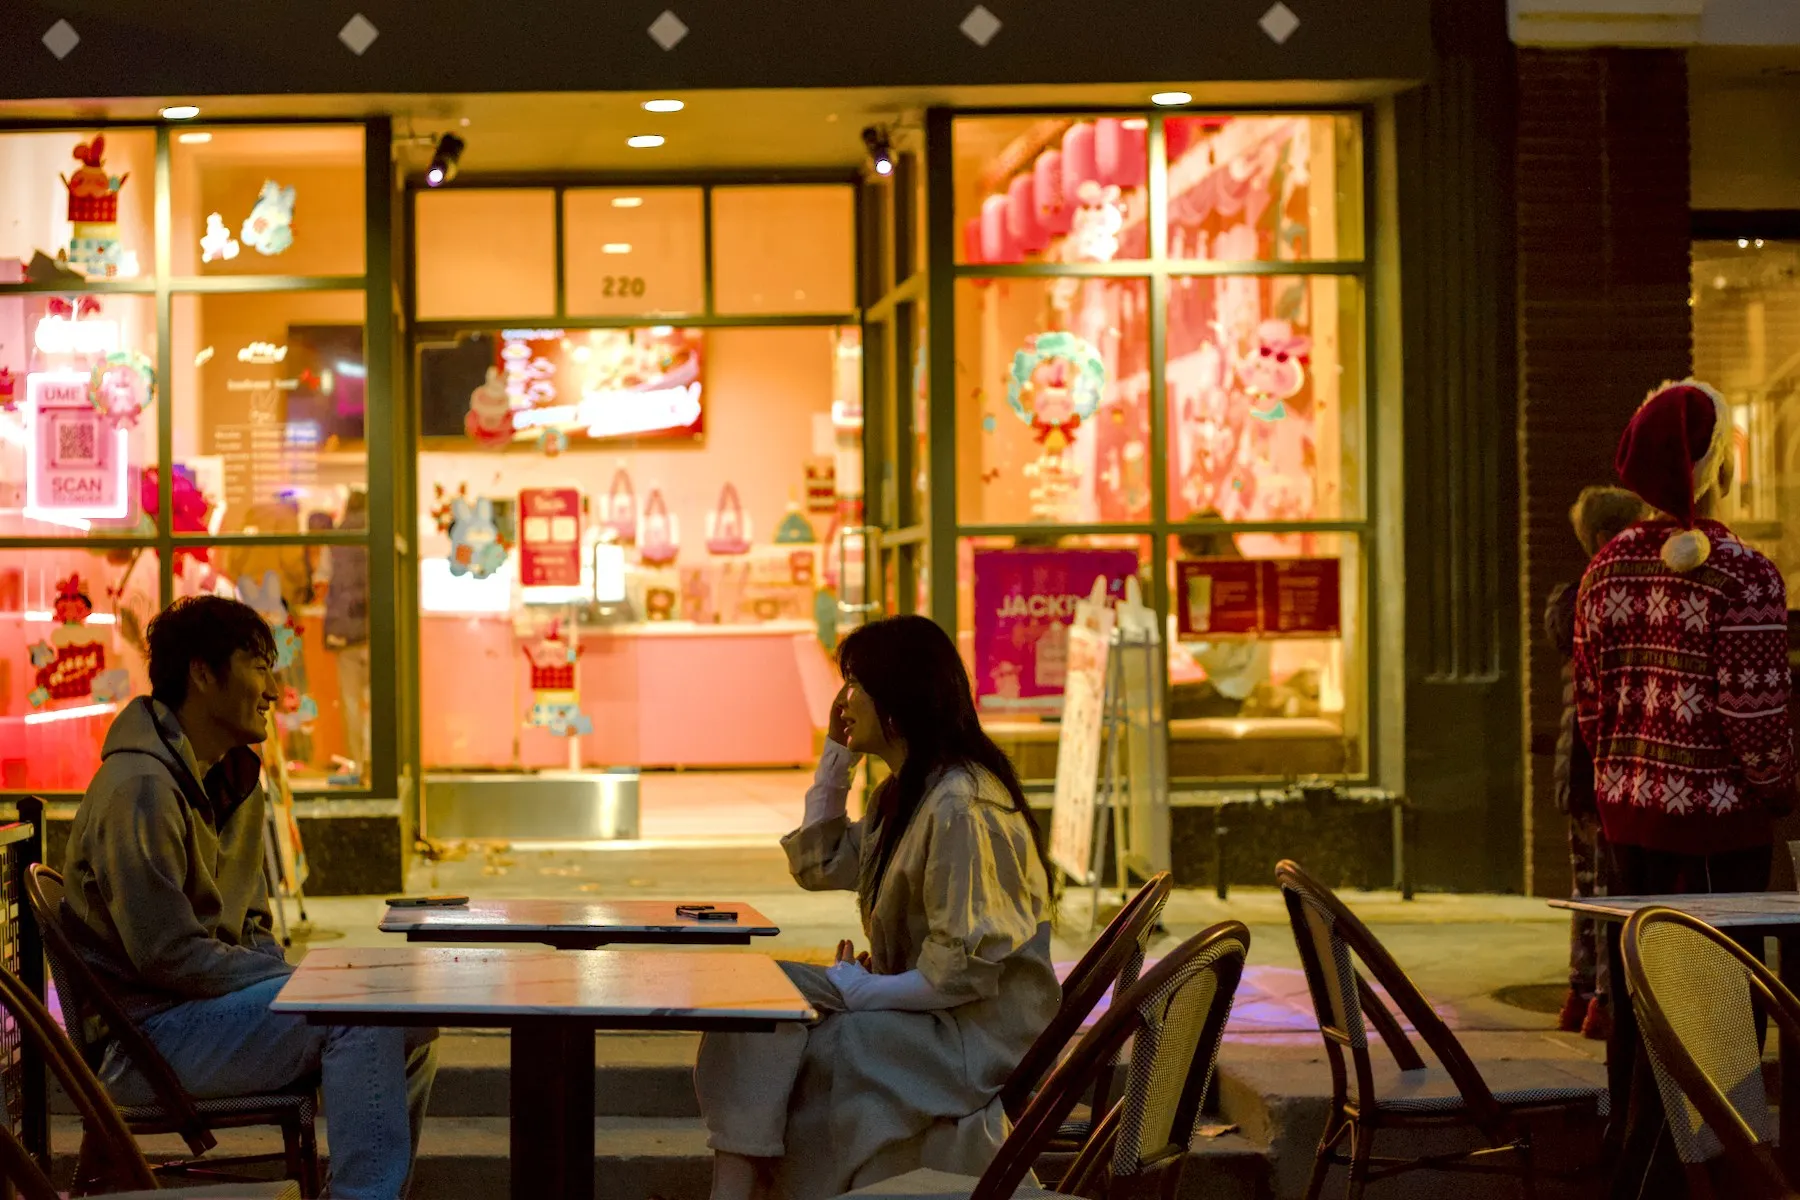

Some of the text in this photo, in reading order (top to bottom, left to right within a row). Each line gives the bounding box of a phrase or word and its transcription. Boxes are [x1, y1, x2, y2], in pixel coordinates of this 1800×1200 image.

[602, 276, 645, 297] 220
[52, 476, 102, 492] SCAN
[997, 594, 1119, 618] JACKP
